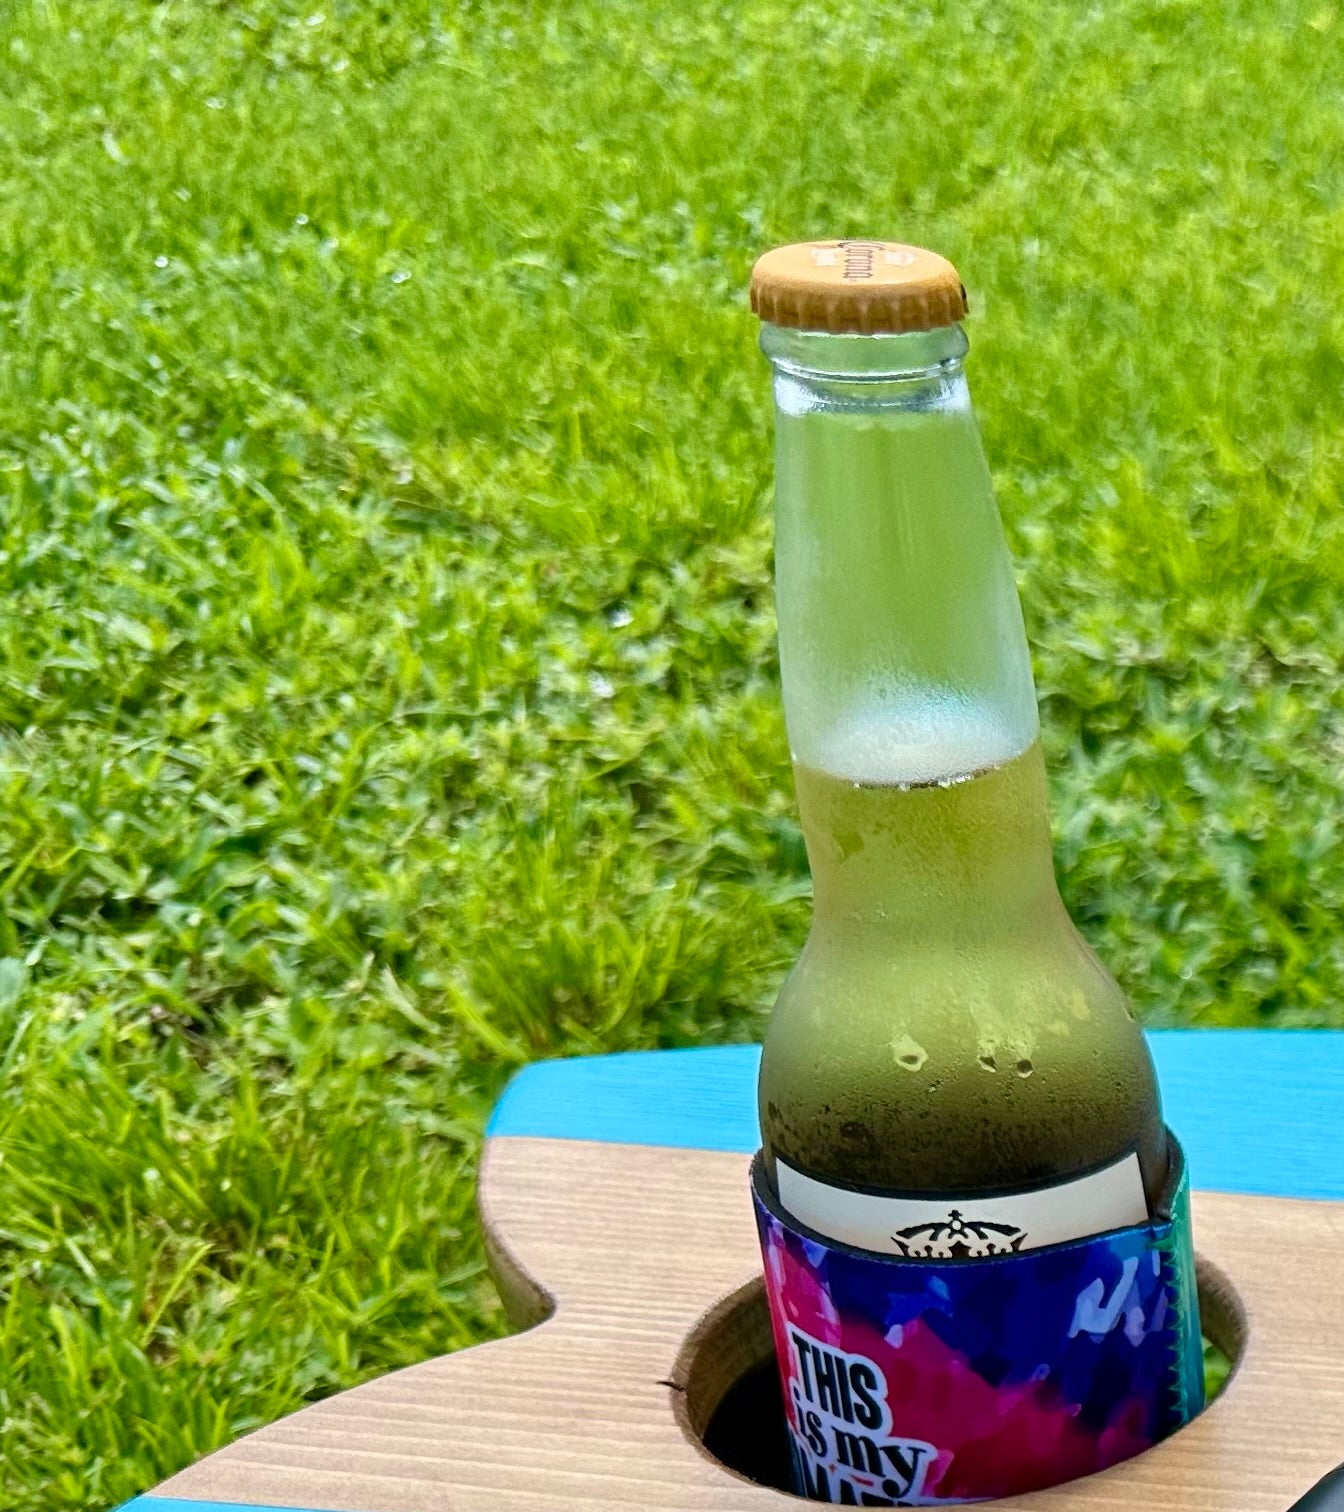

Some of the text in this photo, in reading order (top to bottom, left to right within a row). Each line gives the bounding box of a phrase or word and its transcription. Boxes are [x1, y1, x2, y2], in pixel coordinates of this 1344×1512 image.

[792, 1331, 884, 1430] THIS
[793, 1384, 828, 1458] is
[831, 1425, 926, 1499] my
